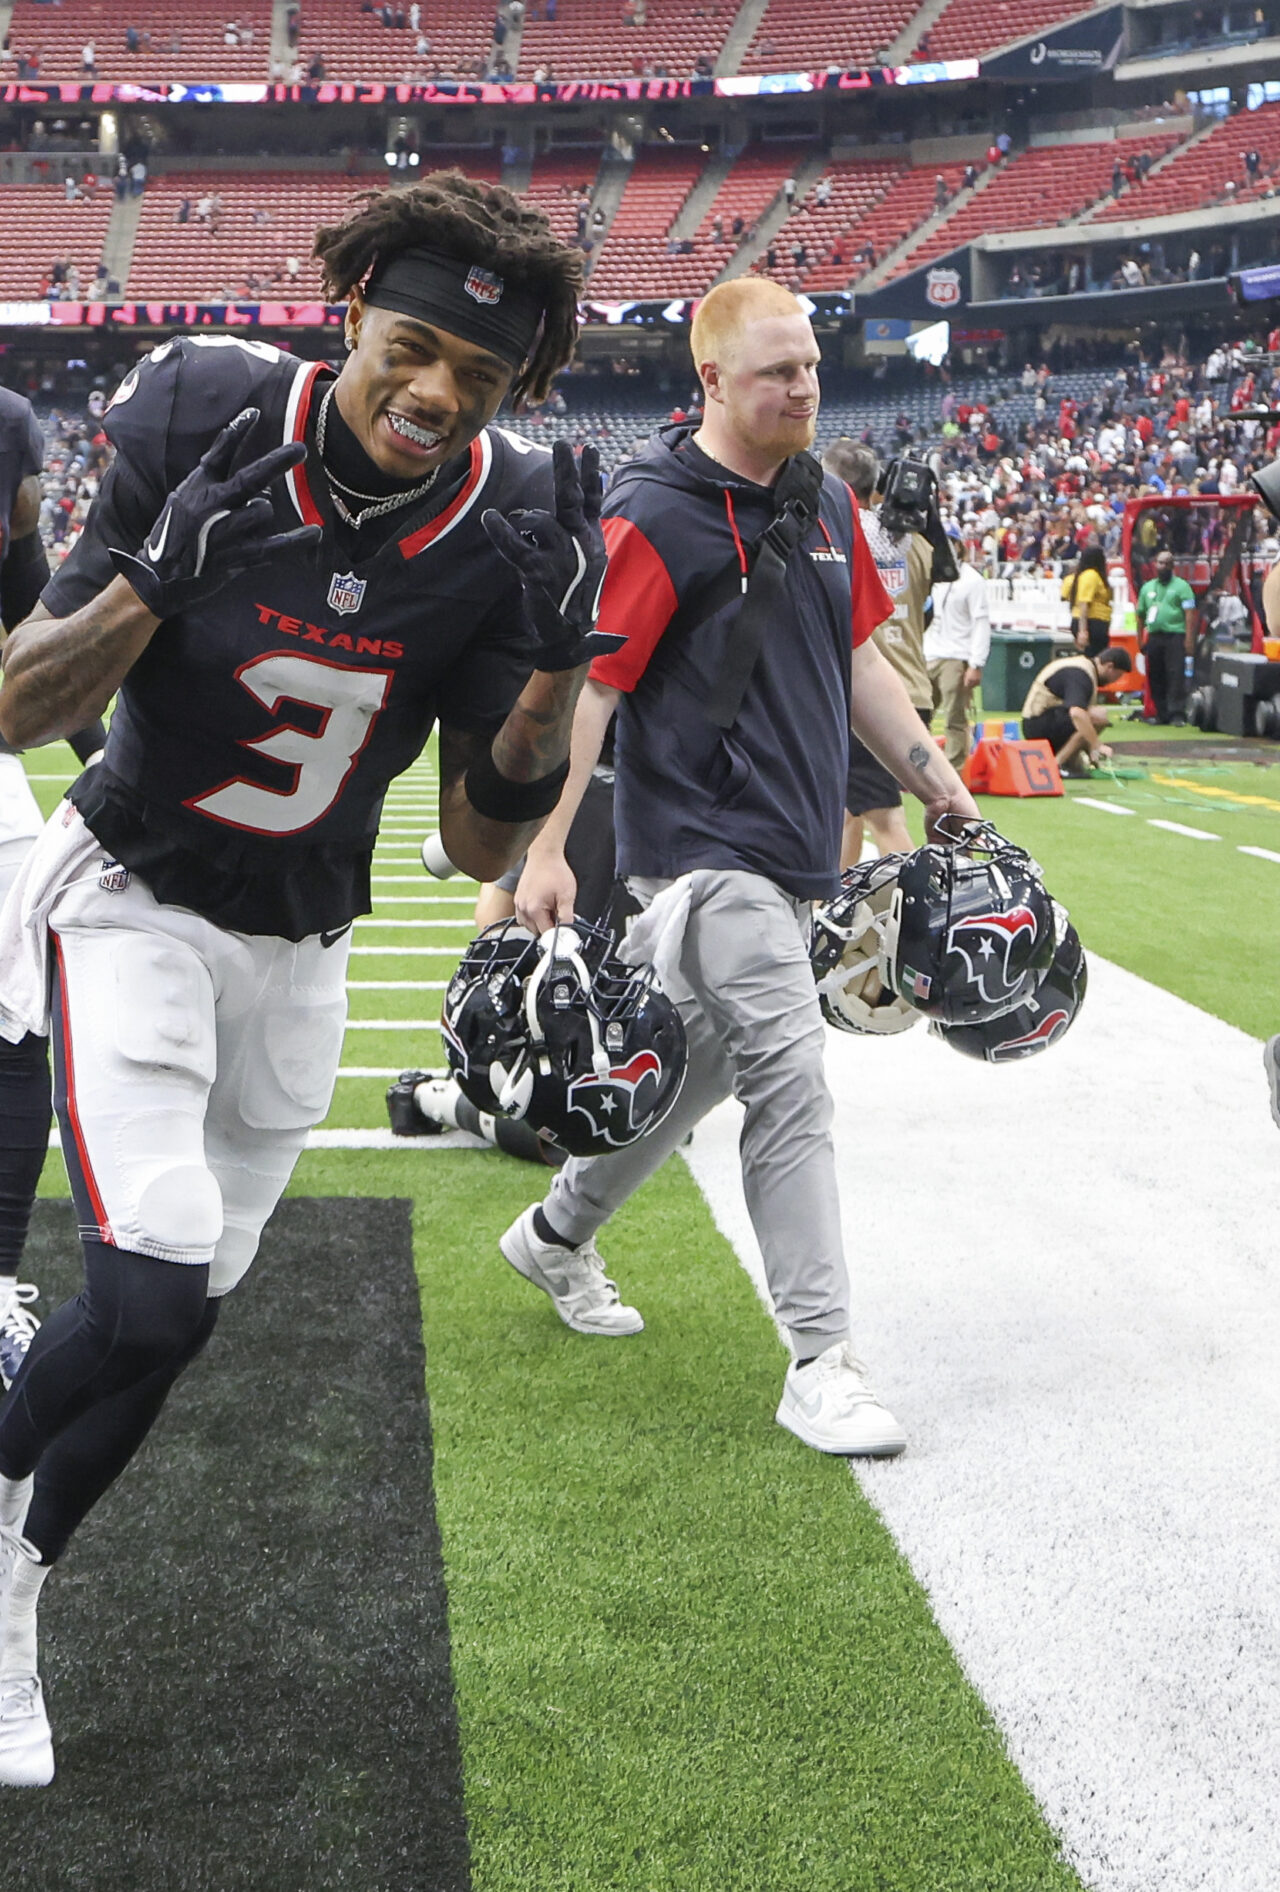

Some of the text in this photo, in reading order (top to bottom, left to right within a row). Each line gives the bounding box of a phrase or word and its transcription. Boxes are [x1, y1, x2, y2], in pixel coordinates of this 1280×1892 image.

[809, 552, 847, 564] TEXNS
[333, 588, 358, 608] NFL
[254, 602, 404, 658] TEXANS
[181, 648, 396, 838] 3
[1019, 749, 1054, 791] G
[101, 871, 125, 889] NFL
